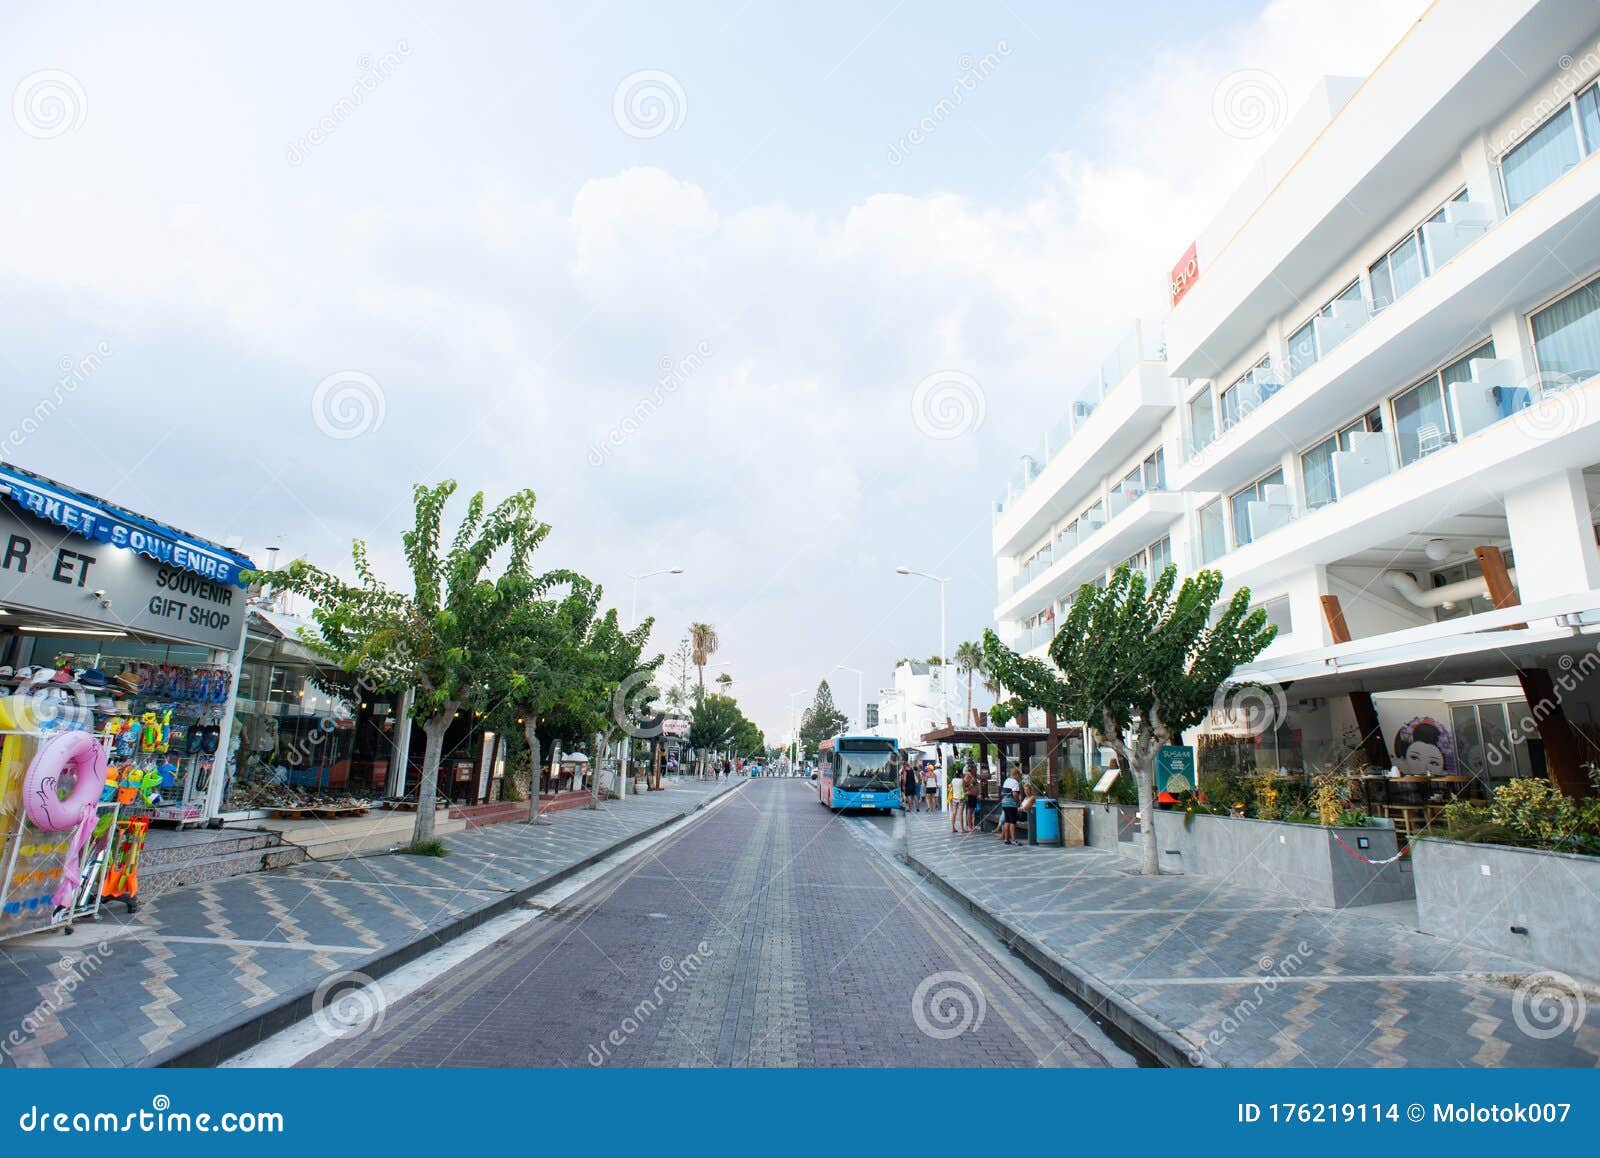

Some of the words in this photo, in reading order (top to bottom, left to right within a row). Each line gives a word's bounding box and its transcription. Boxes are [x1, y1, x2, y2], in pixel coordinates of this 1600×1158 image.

[156, 568, 233, 607] SOUVENIR
[149, 595, 187, 621] GIFT
[188, 605, 230, 630] SHOP
